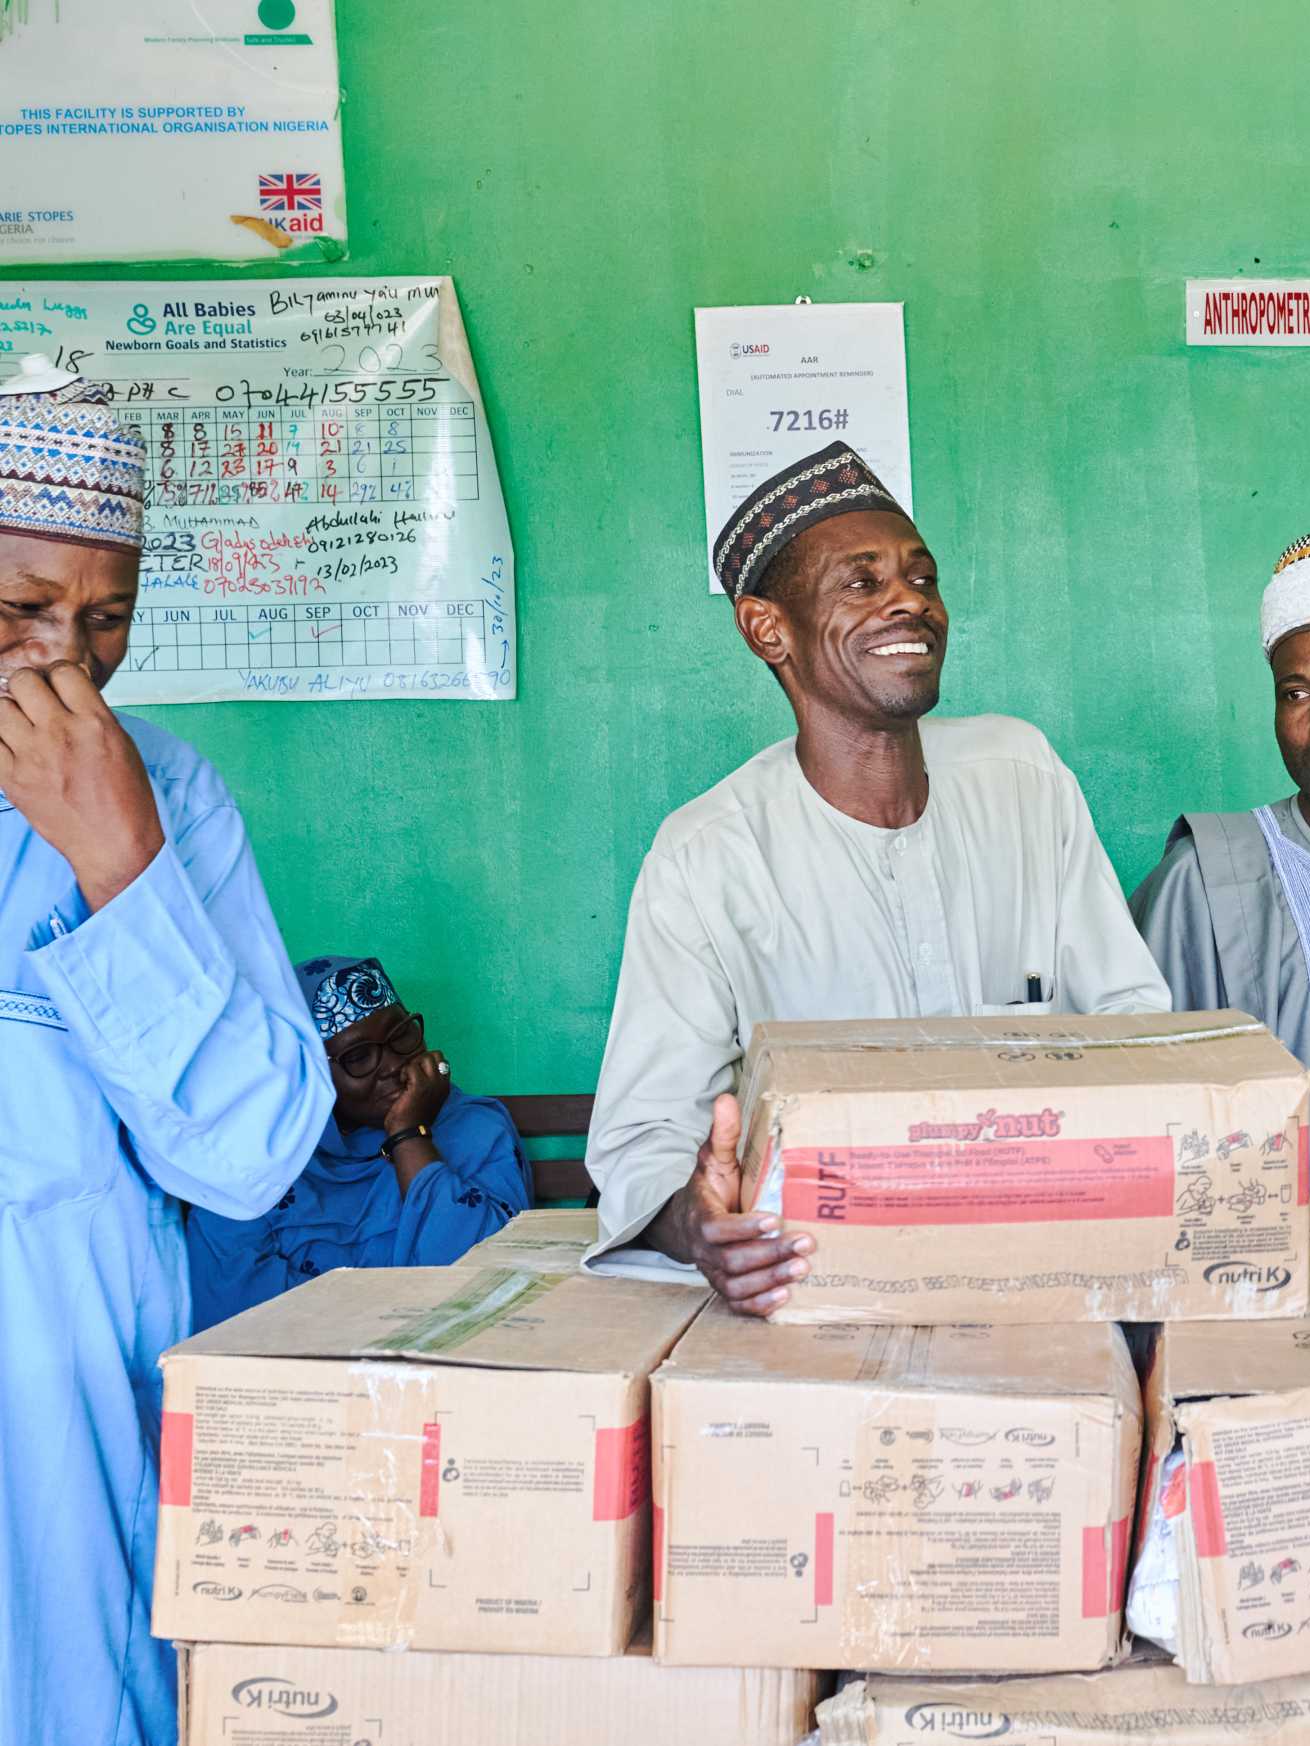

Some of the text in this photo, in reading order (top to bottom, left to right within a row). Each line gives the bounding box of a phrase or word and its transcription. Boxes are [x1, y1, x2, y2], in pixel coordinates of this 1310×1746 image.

[21, 106, 246, 119] THIS FACILITY IS SUPPORTED BY
[47, 122, 157, 134] INTERNATIONAL
[163, 121, 269, 133] ORGANISATION
[274, 120, 328, 132] NIGERIA
[28, 210, 74, 222] STOPES
[163, 302, 256, 317] All Babies
[165, 319, 252, 337] Are Equal
[105, 337, 287, 351] Newborn Goals and Statistics
[742, 344, 770, 354] USAID
[801, 356, 819, 364] AAR
[283, 366, 312, 377] Year:
[726, 388, 744, 397] DIAL
[124, 406, 468, 421] FEB MAR APR MAY JUN JUL AUG SEP OCT NOV DEC
[164, 603, 474, 622] JUN JUL AUG SEP OCT NOV DEC
[816, 1150, 847, 1221] RUTF
[1218, 1266, 1280, 1284] nutri K
[200, 1584, 225, 1596] nutri
[245, 1688, 320, 1709] nutri K
[918, 1712, 937, 1731] K
[941, 1710, 994, 1732] nutri
